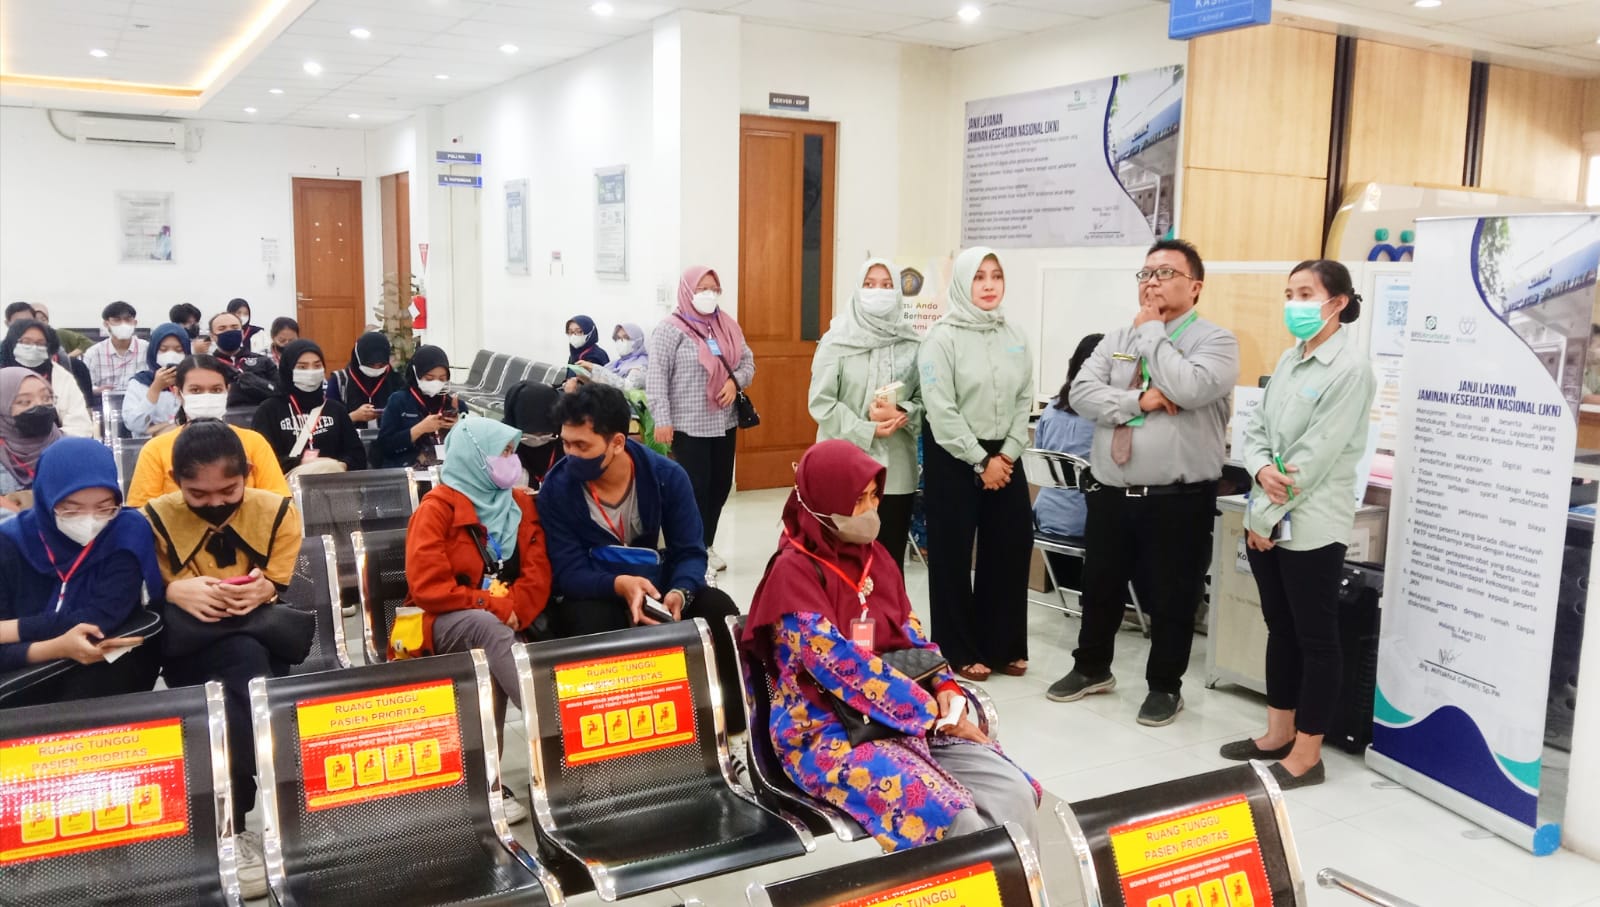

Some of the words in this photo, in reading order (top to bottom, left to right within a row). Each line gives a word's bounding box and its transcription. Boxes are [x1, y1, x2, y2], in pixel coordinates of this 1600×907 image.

[968, 117, 980, 129] JANJI
[980, 113, 1003, 128] LAYANAN
[968, 130, 987, 144] JAMINAN
[989, 126, 1017, 140] KESEHATAN
[1019, 123, 1043, 136] NASIONAL
[1458, 380, 1478, 392] JANJI
[1479, 383, 1517, 397] LAYANAN
[1418, 389, 1449, 403] JAMINAN
[1450, 393, 1495, 409] KESEHATAN
[1497, 401, 1536, 414] NASIONAL
[587, 666, 618, 677] RUANG
[335, 701, 373, 714] RUANG
[375, 694, 419, 707] TUNGGU
[330, 716, 369, 728] PASIEN
[371, 705, 426, 721] PRIORITAS
[38, 742, 84, 757] RUANG
[88, 734, 140, 749] TUNGGU
[31, 757, 78, 772] PASIEN
[82, 748, 148, 764] PRIORITAS
[1146, 825, 1180, 842] RUANG
[1182, 815, 1220, 833] TUNGGU
[1144, 844, 1180, 860] PASIEN
[1181, 831, 1229, 851] PRIORITAS
[907, 888, 957, 907] TUNGGU
